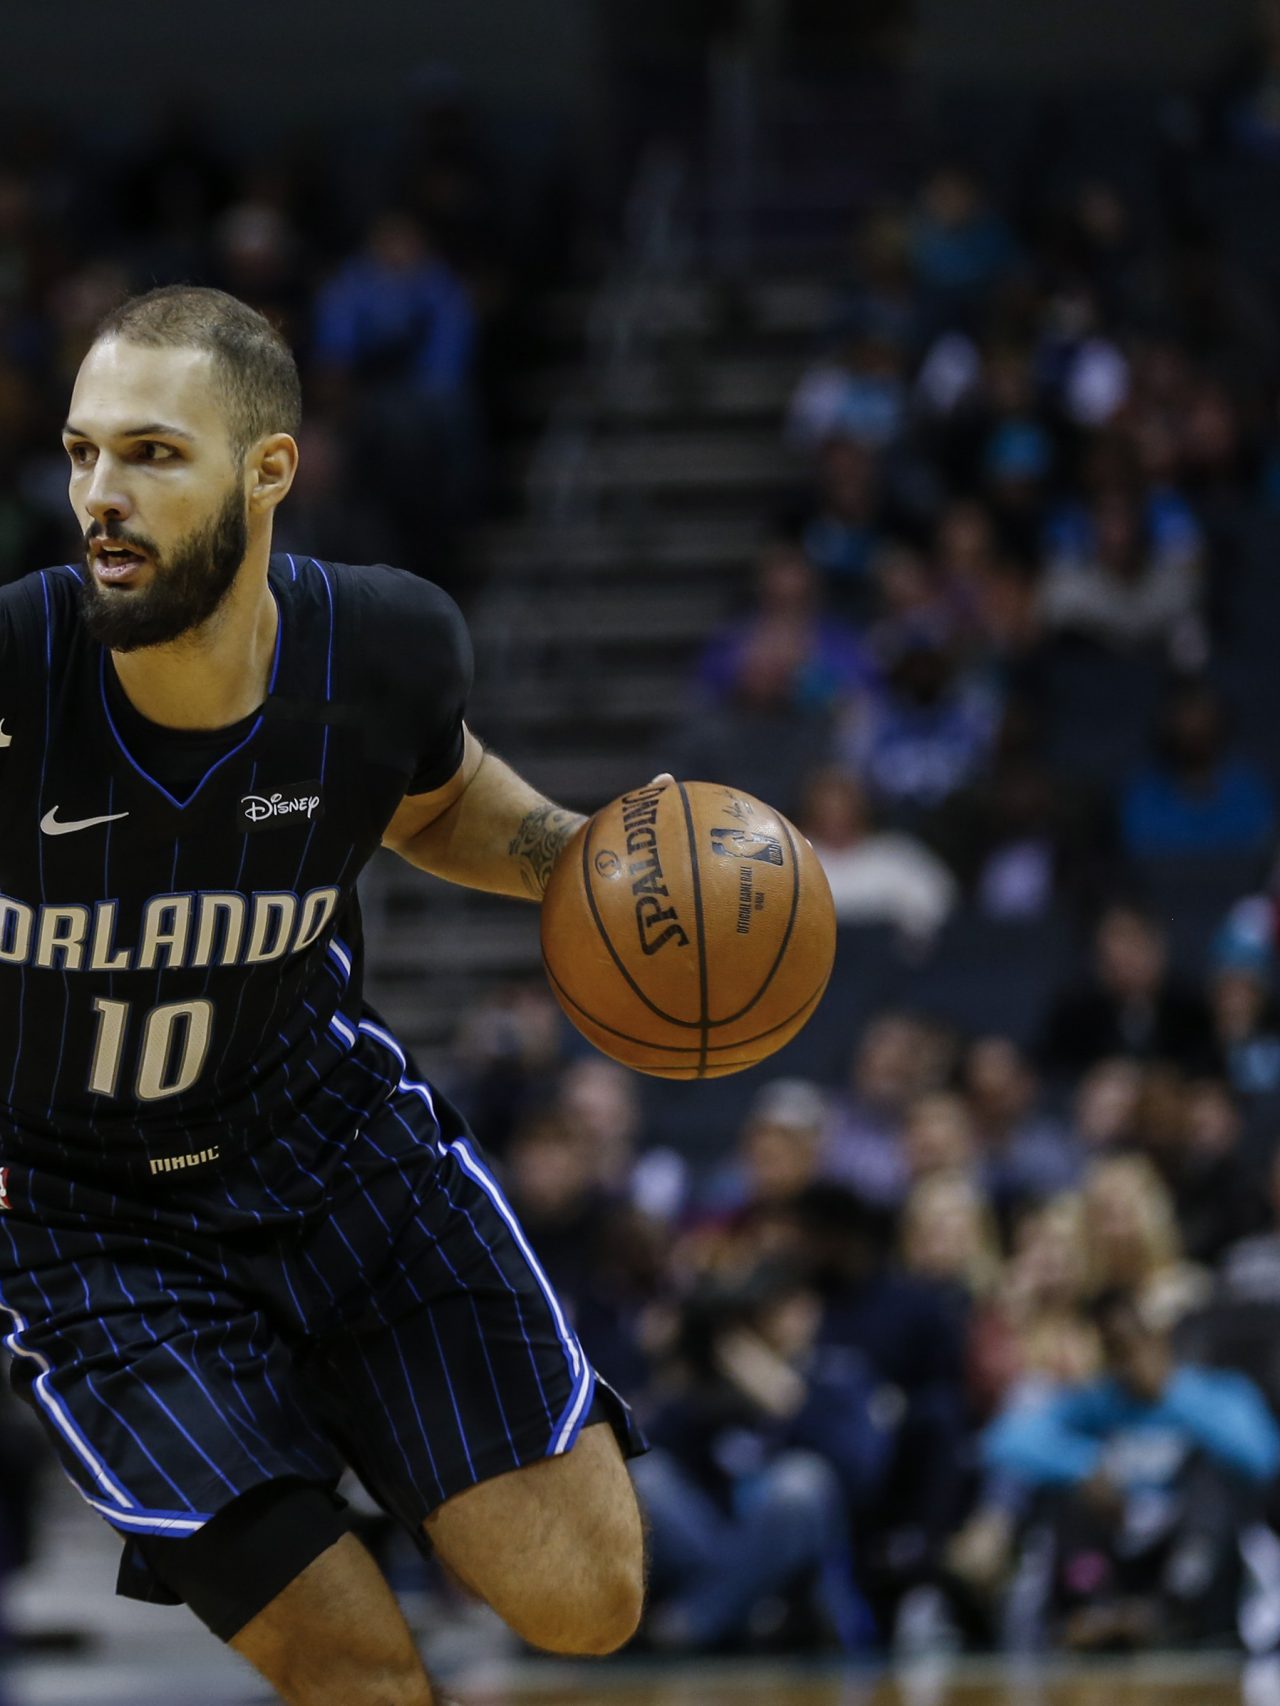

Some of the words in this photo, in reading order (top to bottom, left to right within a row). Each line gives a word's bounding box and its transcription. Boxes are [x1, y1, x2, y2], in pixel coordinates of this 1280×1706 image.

[622, 786, 690, 956] SPALDING
[736, 903, 752, 934] OFFICIAL
[86, 997, 215, 1100] 10
